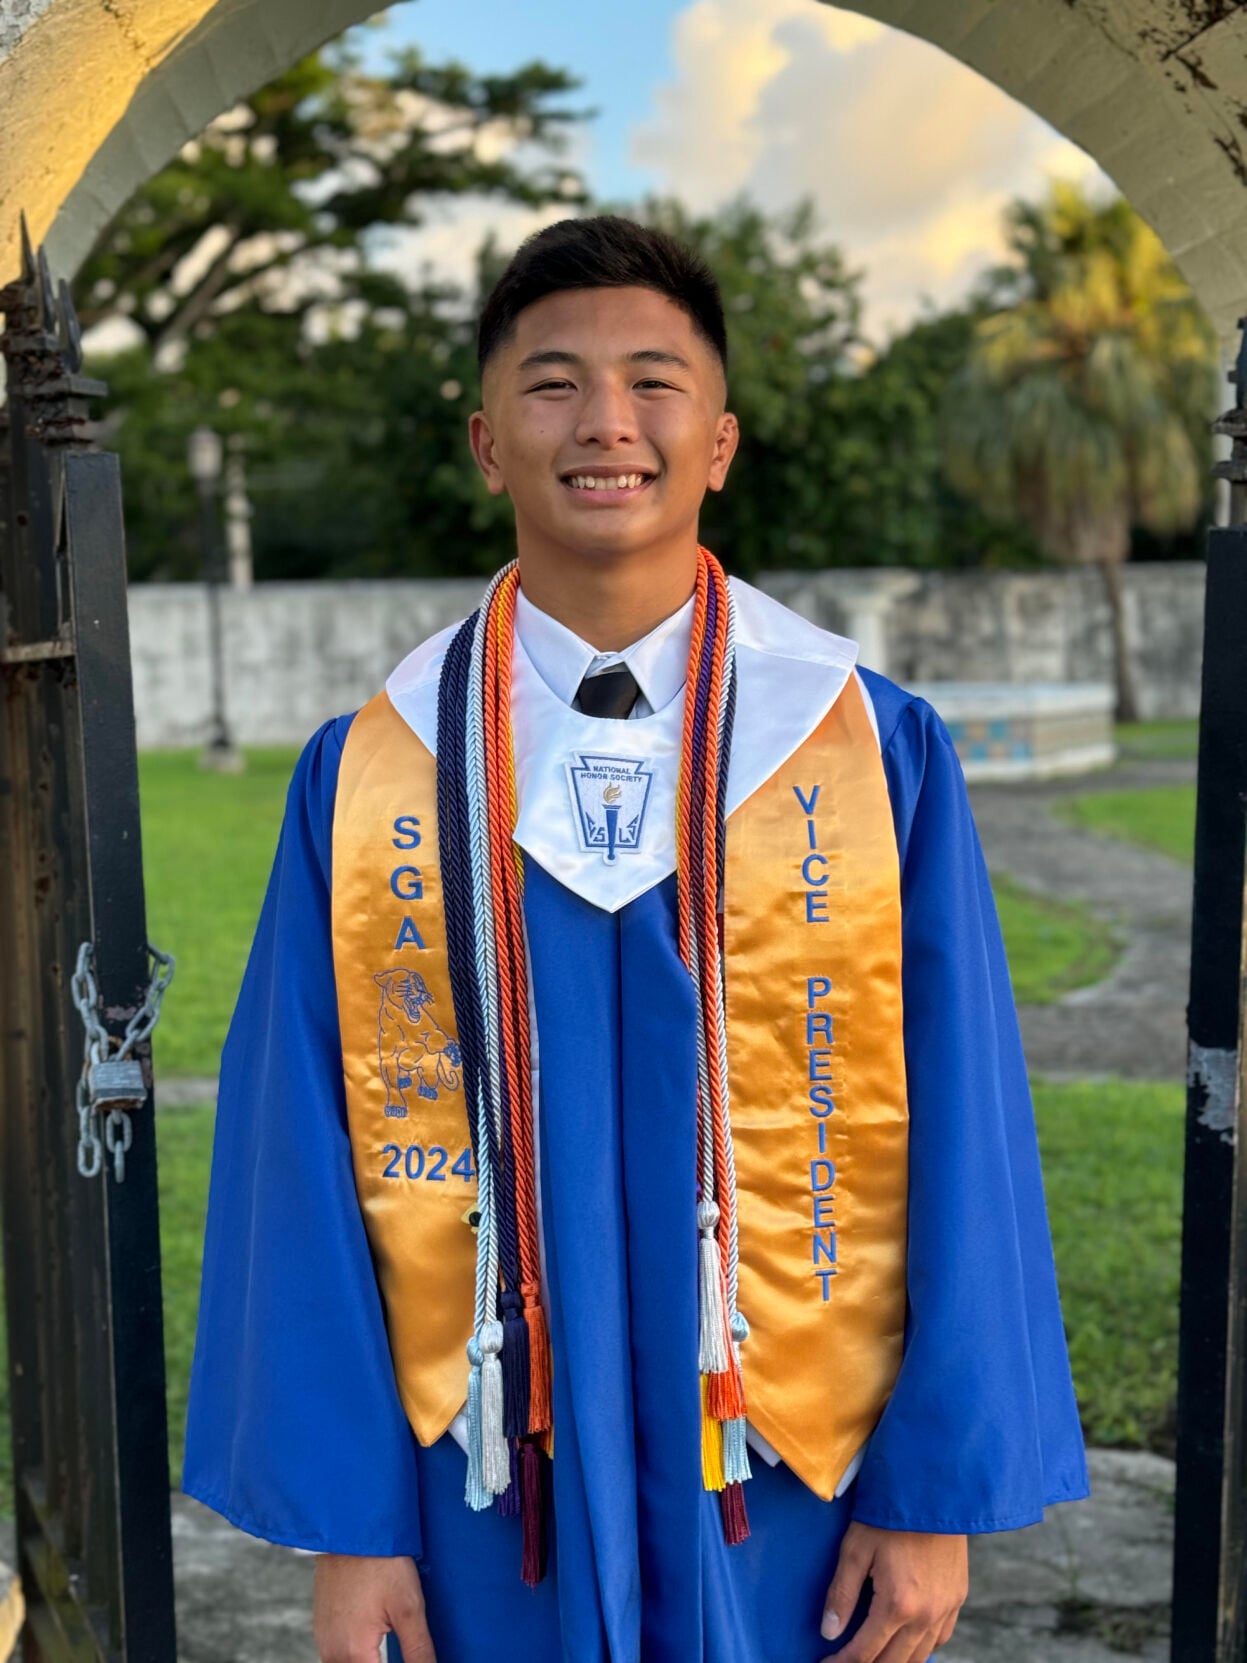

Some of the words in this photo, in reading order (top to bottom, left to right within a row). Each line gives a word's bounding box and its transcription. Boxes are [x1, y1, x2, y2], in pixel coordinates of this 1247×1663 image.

[580, 771, 608, 780] HONOR
[610, 774, 642, 783] SOCIETY
[593, 765, 631, 774] NATIONAL
[390, 815, 425, 950] SGA
[793, 784, 829, 923] VICE
[382, 1143, 476, 1183] 2024
[806, 976, 837, 1302] PRESIDENT
